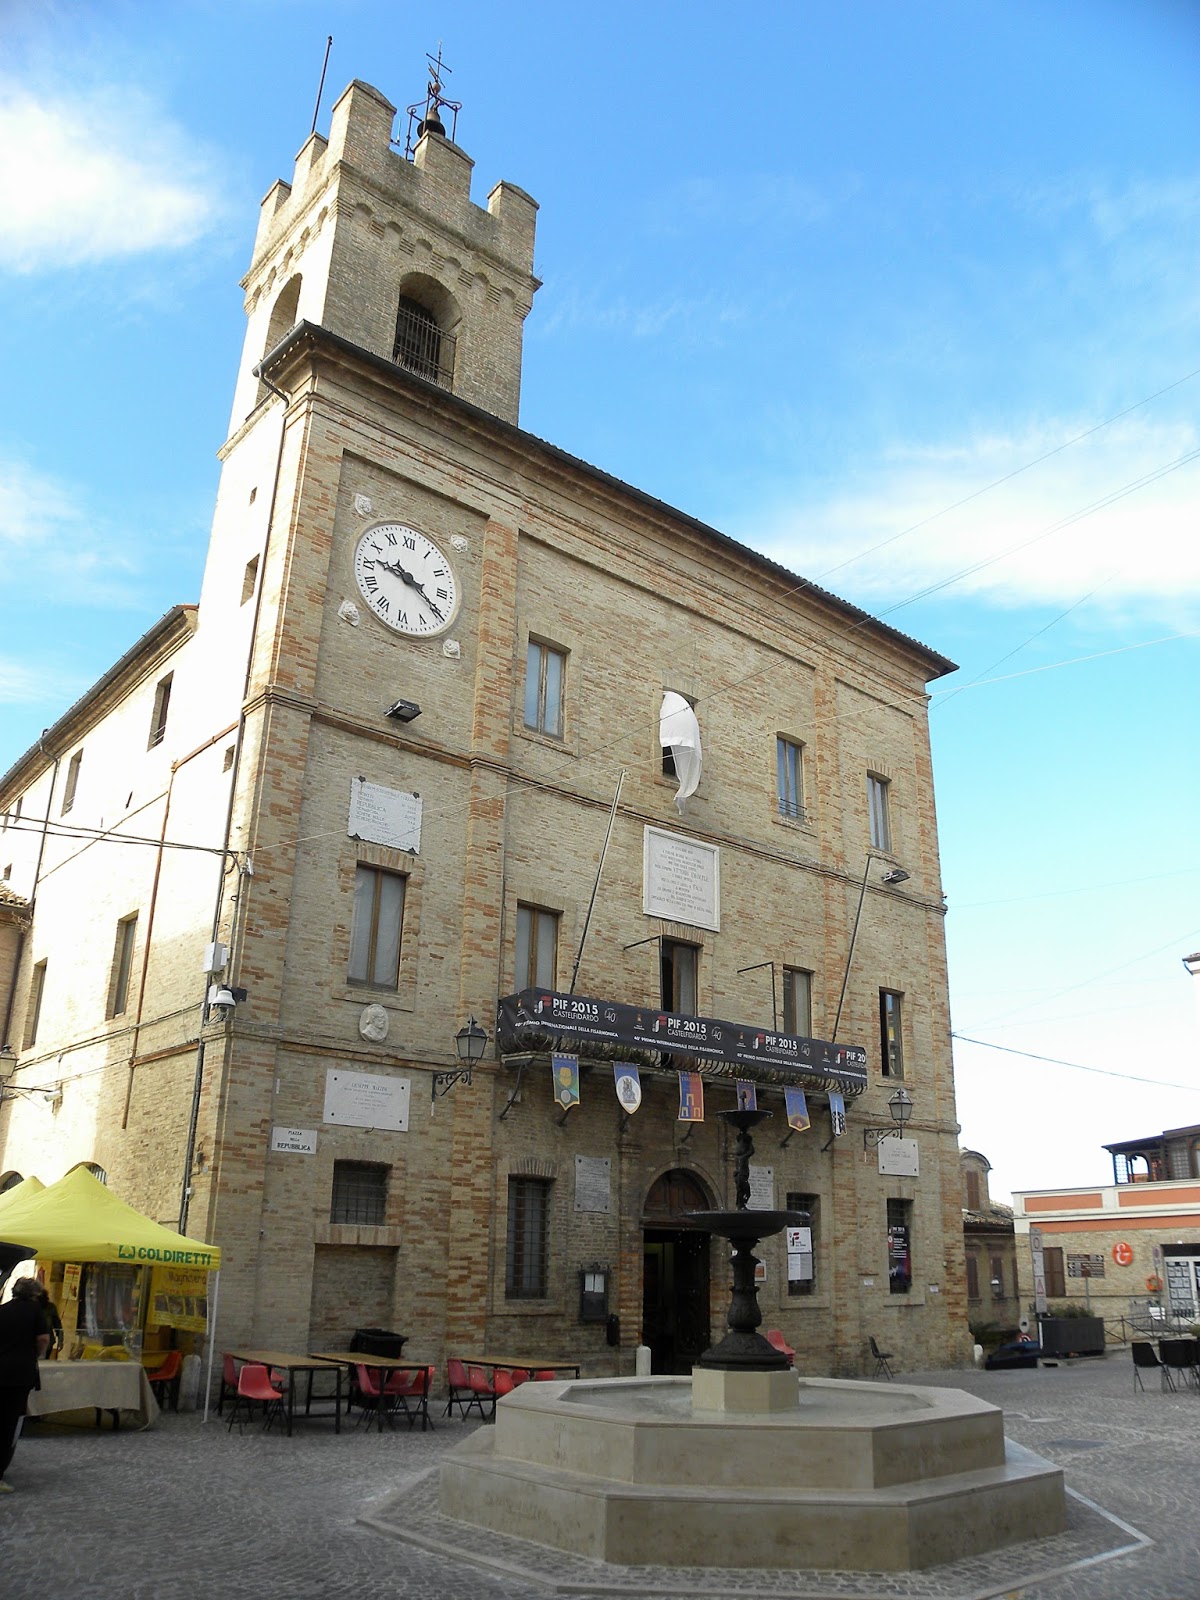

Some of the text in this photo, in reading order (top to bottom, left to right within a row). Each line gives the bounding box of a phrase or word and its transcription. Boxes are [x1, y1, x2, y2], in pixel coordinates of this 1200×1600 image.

[385, 533, 398, 546] XI
[402, 535, 415, 551] XII
[370, 541, 383, 554] X
[423, 551, 431, 559] I
[433, 569, 445, 577] II
[364, 576, 379, 594] VIII
[436, 587, 448, 600] III
[376, 596, 390, 612] VII
[398, 609, 408, 624] VI
[419, 613, 427, 625] V
[553, 998, 599, 1015] PIF 2015
[553, 1009, 599, 1023] CASTELFIDARDO
[667, 1017, 707, 1034] PIF 2015
[667, 1028, 707, 1041] CASTELFIDARDO
[765, 1035, 798, 1050] PIF 2015
[765, 1045, 798, 1057] CASTELFIDARDO
[846, 1050, 856, 1060] PIF
[277, 1142, 311, 1151] REPUBBLICA
[138, 1247, 211, 1265] COLDIRETTI
